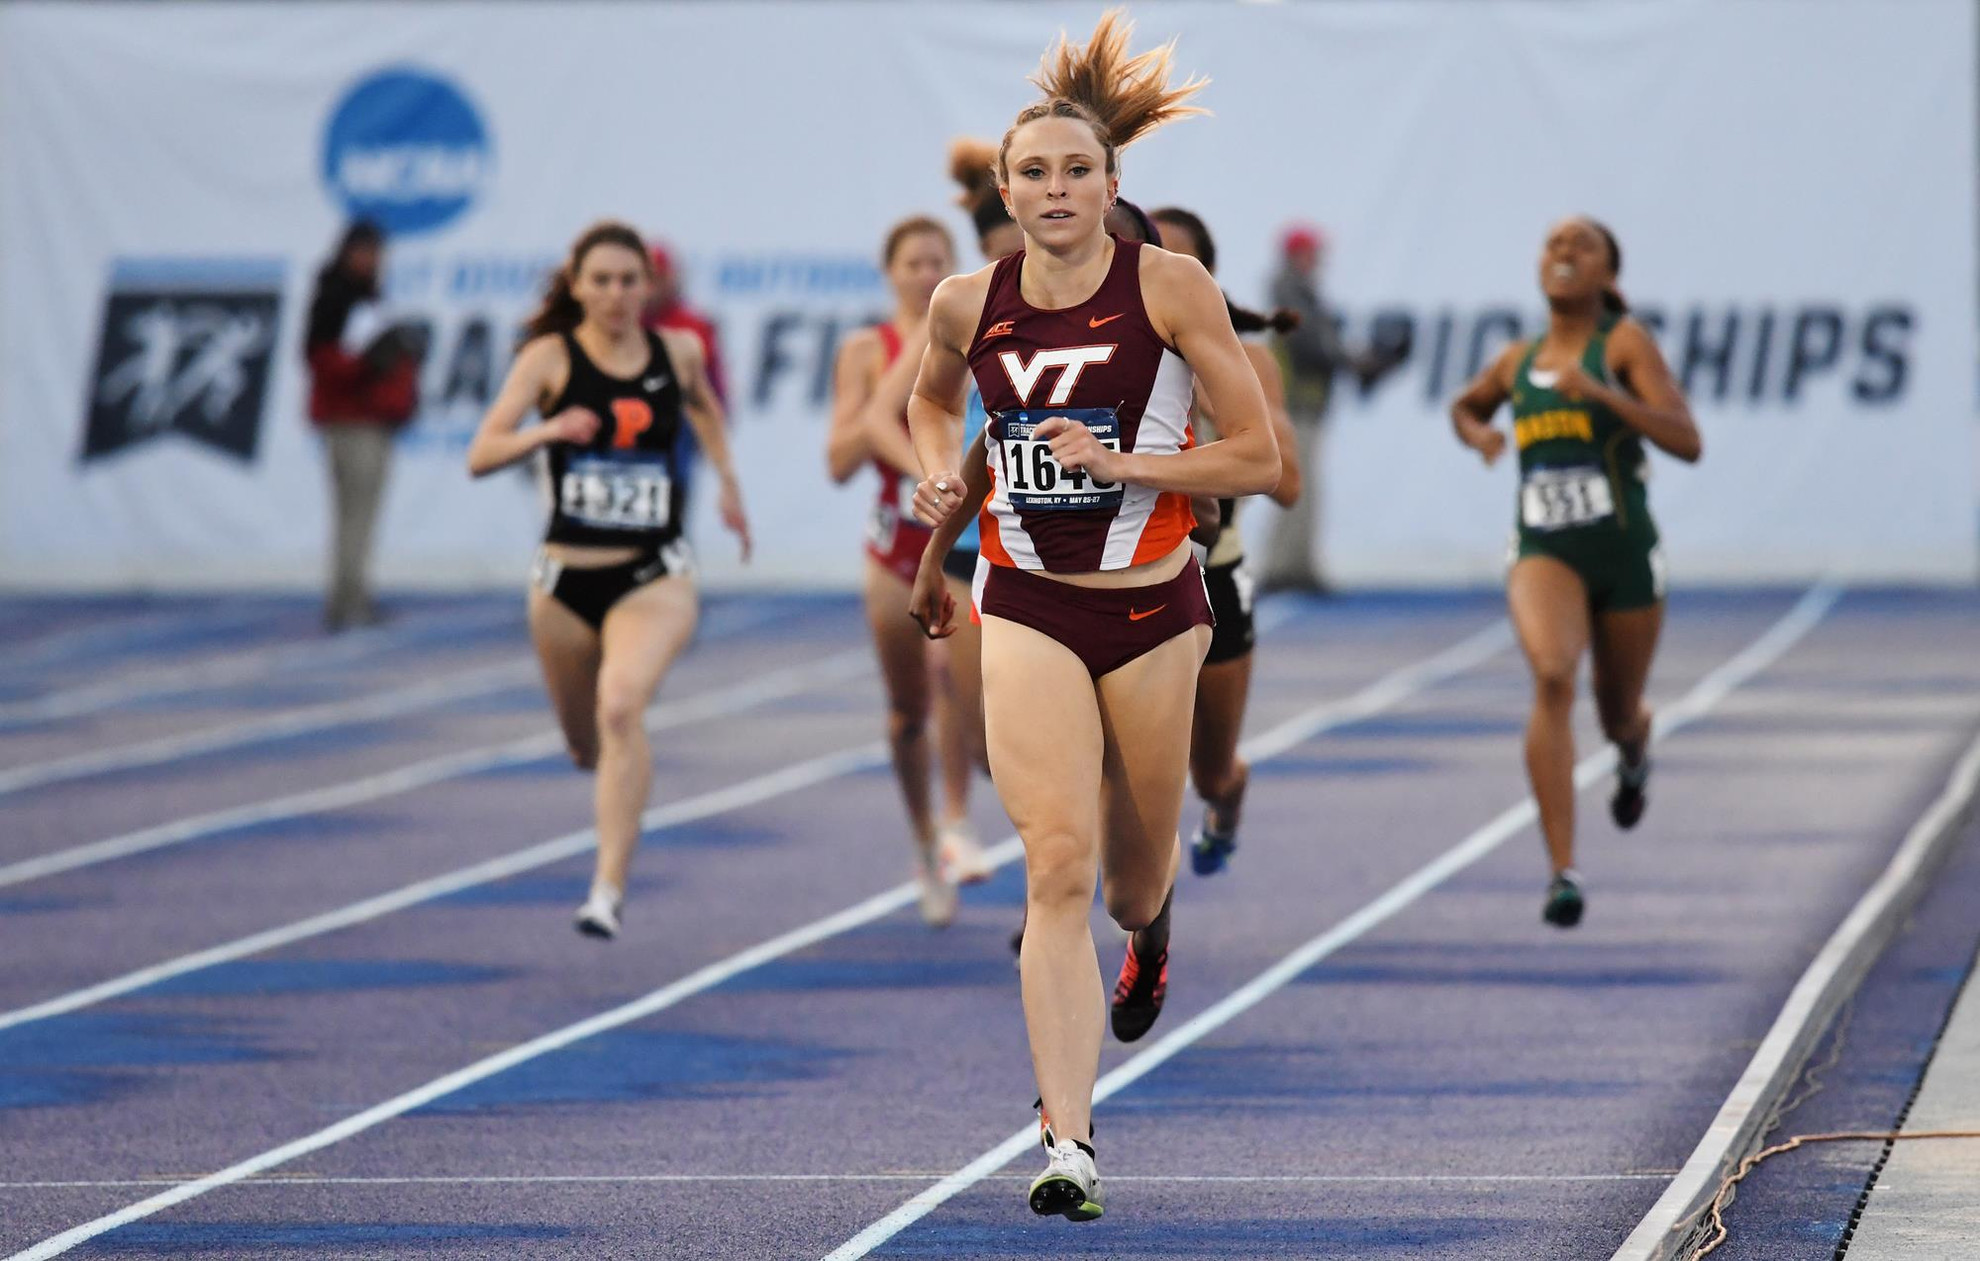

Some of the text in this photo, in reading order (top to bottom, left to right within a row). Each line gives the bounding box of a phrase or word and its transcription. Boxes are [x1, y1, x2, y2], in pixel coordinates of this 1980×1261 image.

[983, 321, 1015, 339] ACC
[998, 344, 1119, 407] VT
[611, 397, 654, 448] P
